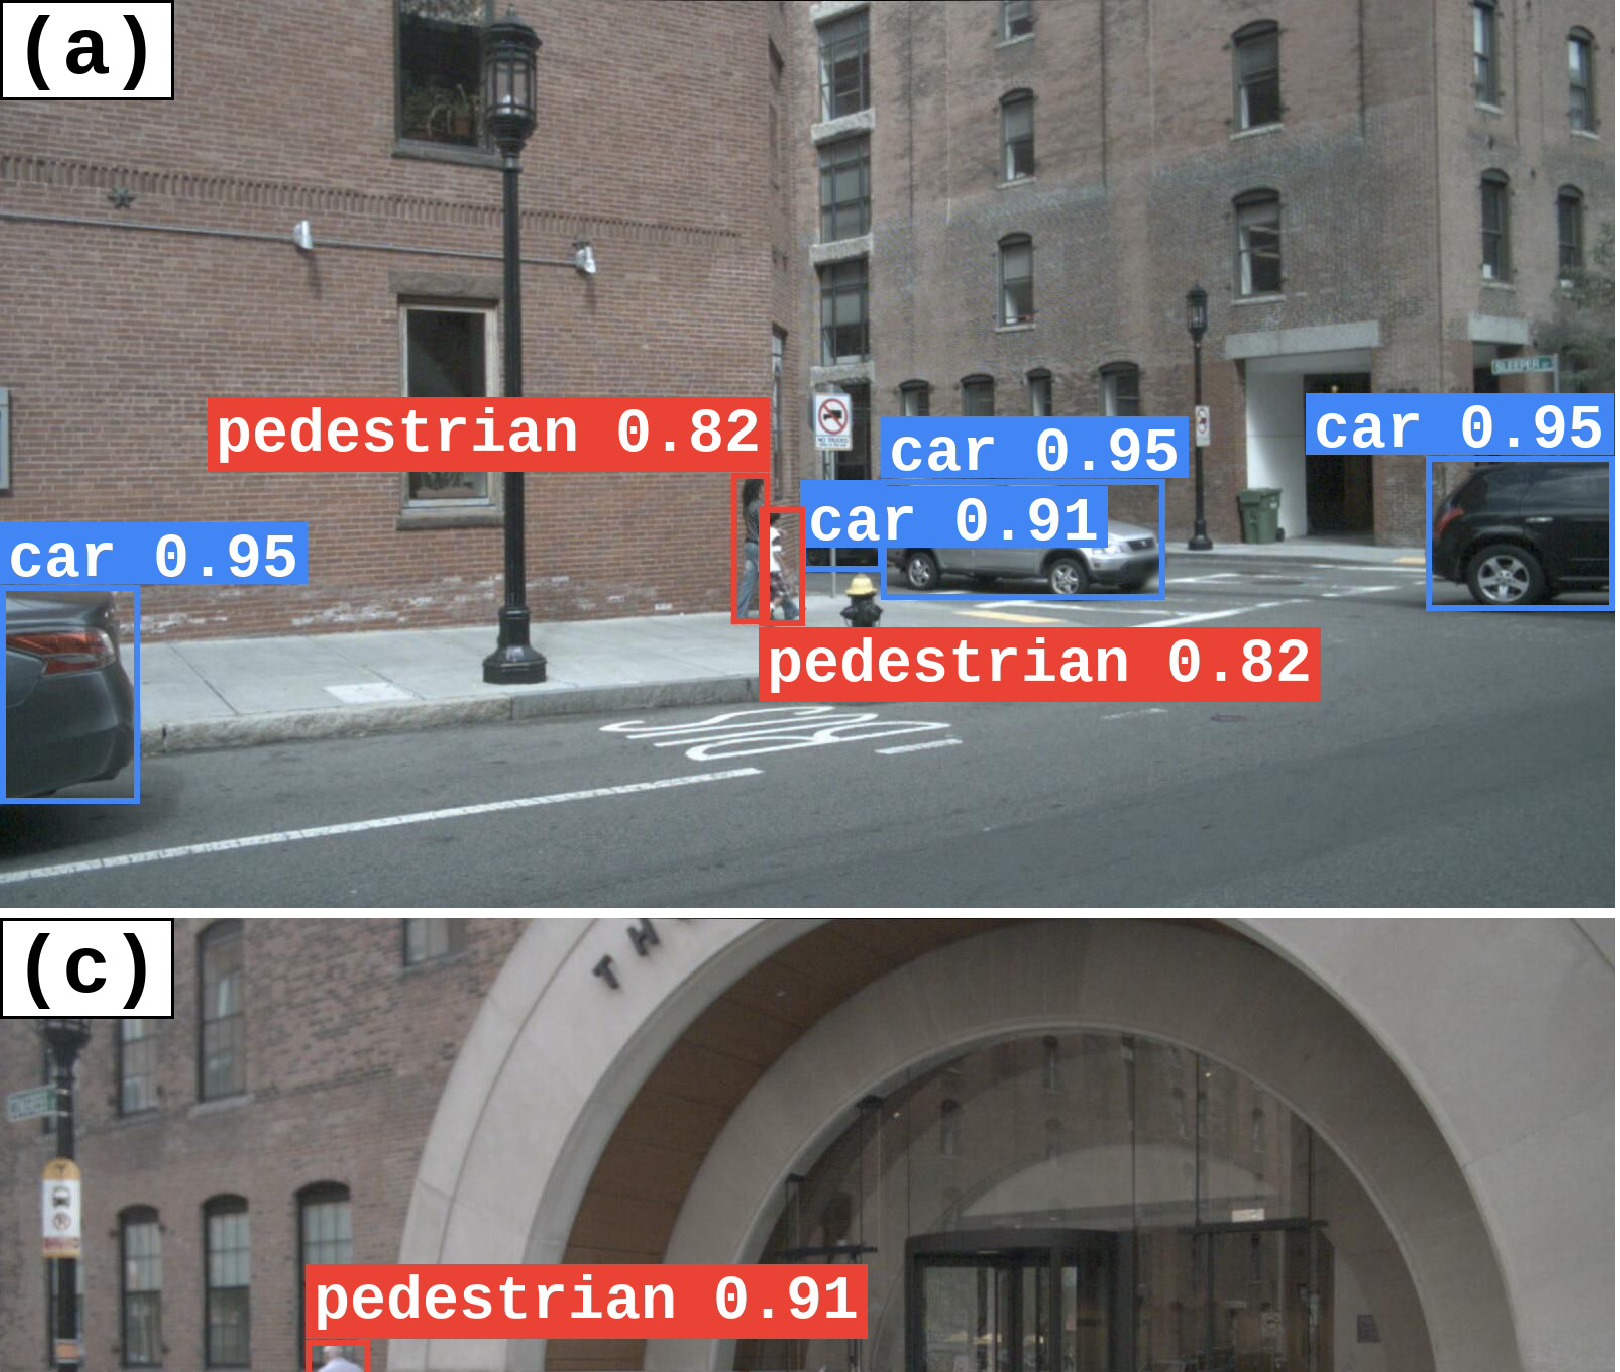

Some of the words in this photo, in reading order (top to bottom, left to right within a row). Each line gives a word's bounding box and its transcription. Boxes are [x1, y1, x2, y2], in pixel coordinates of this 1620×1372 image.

[1494, 358, 1540, 372] SLEEPER
[599, 705, 952, 762] BUS
[593, 918, 694, 989] TH
